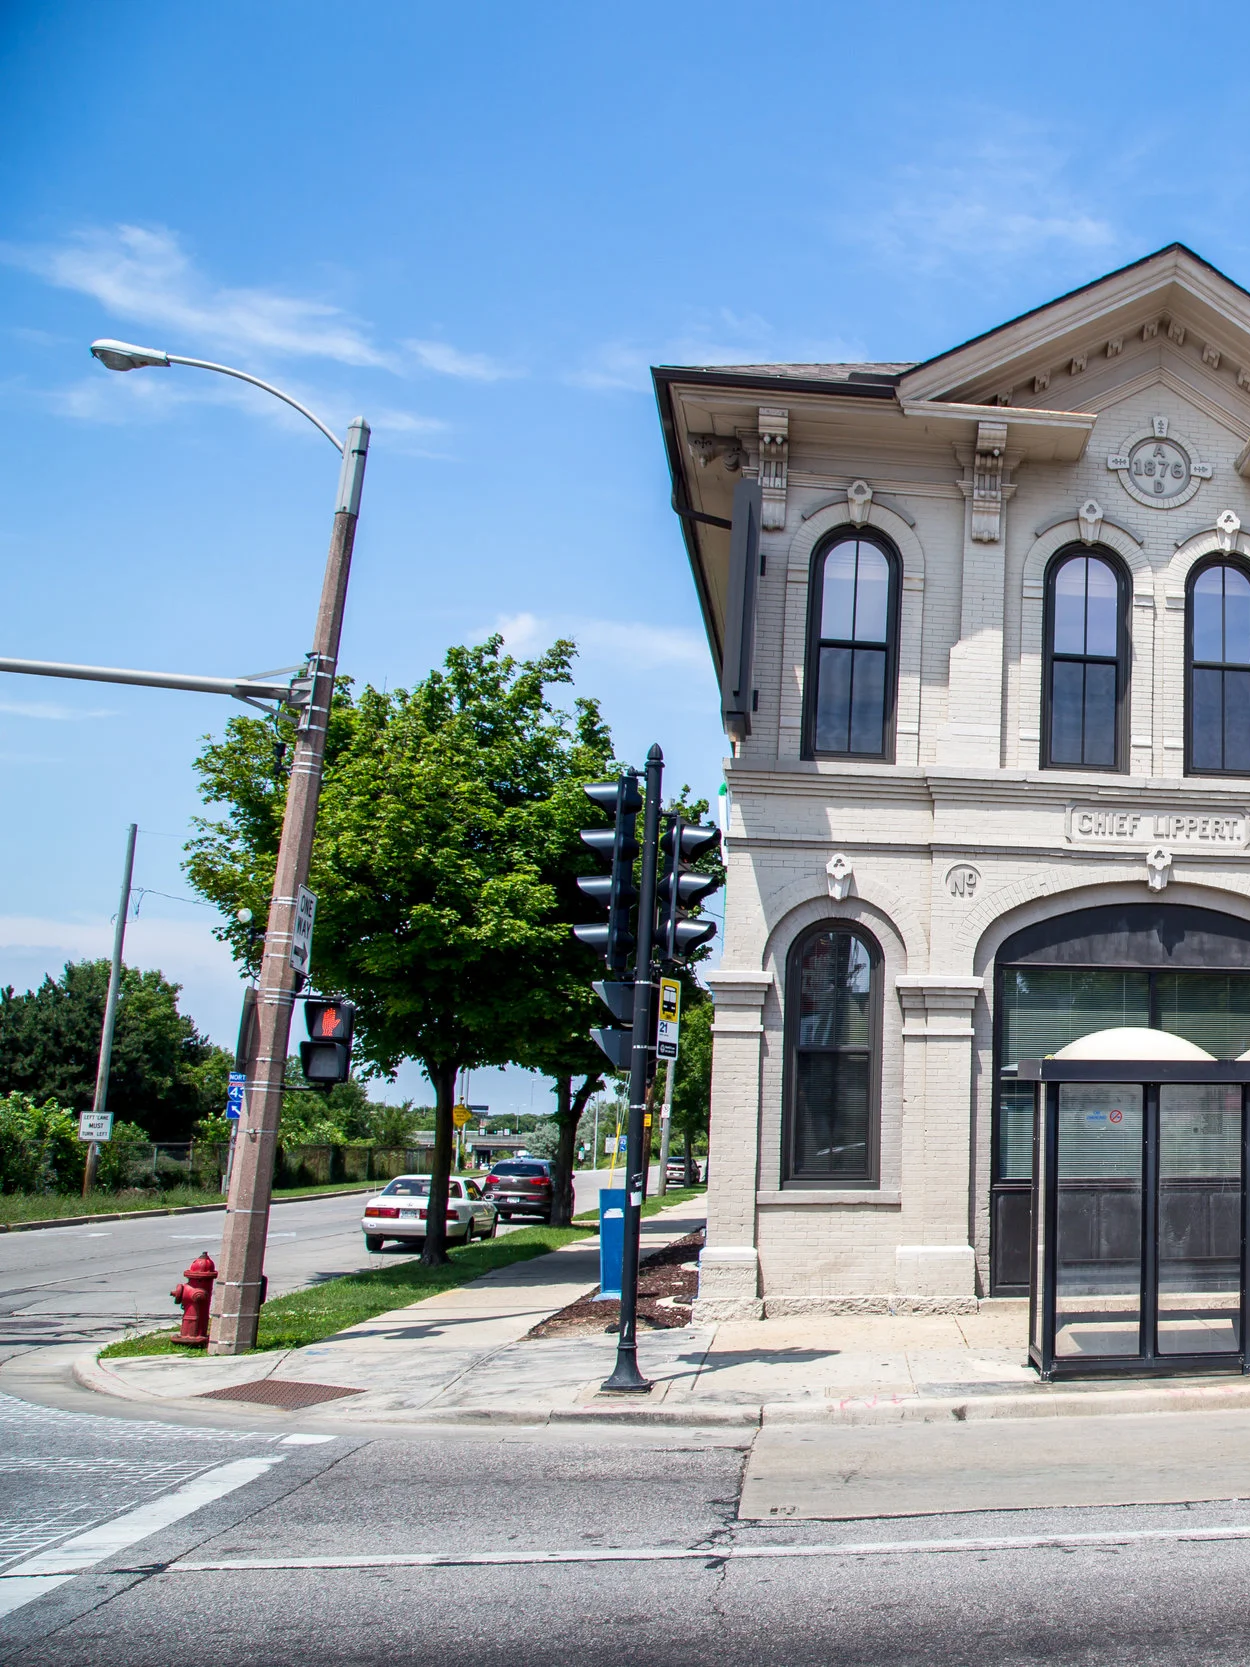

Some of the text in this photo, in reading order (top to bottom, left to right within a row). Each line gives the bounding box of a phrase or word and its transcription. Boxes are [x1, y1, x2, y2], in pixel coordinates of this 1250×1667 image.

[1133, 458, 1184, 479] 1876
[1078, 811, 1241, 840] CHIEF LIPPERT.
[300, 894, 314, 918] ONE
[297, 915, 312, 940] WAY
[659, 1021, 668, 1034] 21
[230, 1087, 245, 1099] 43
